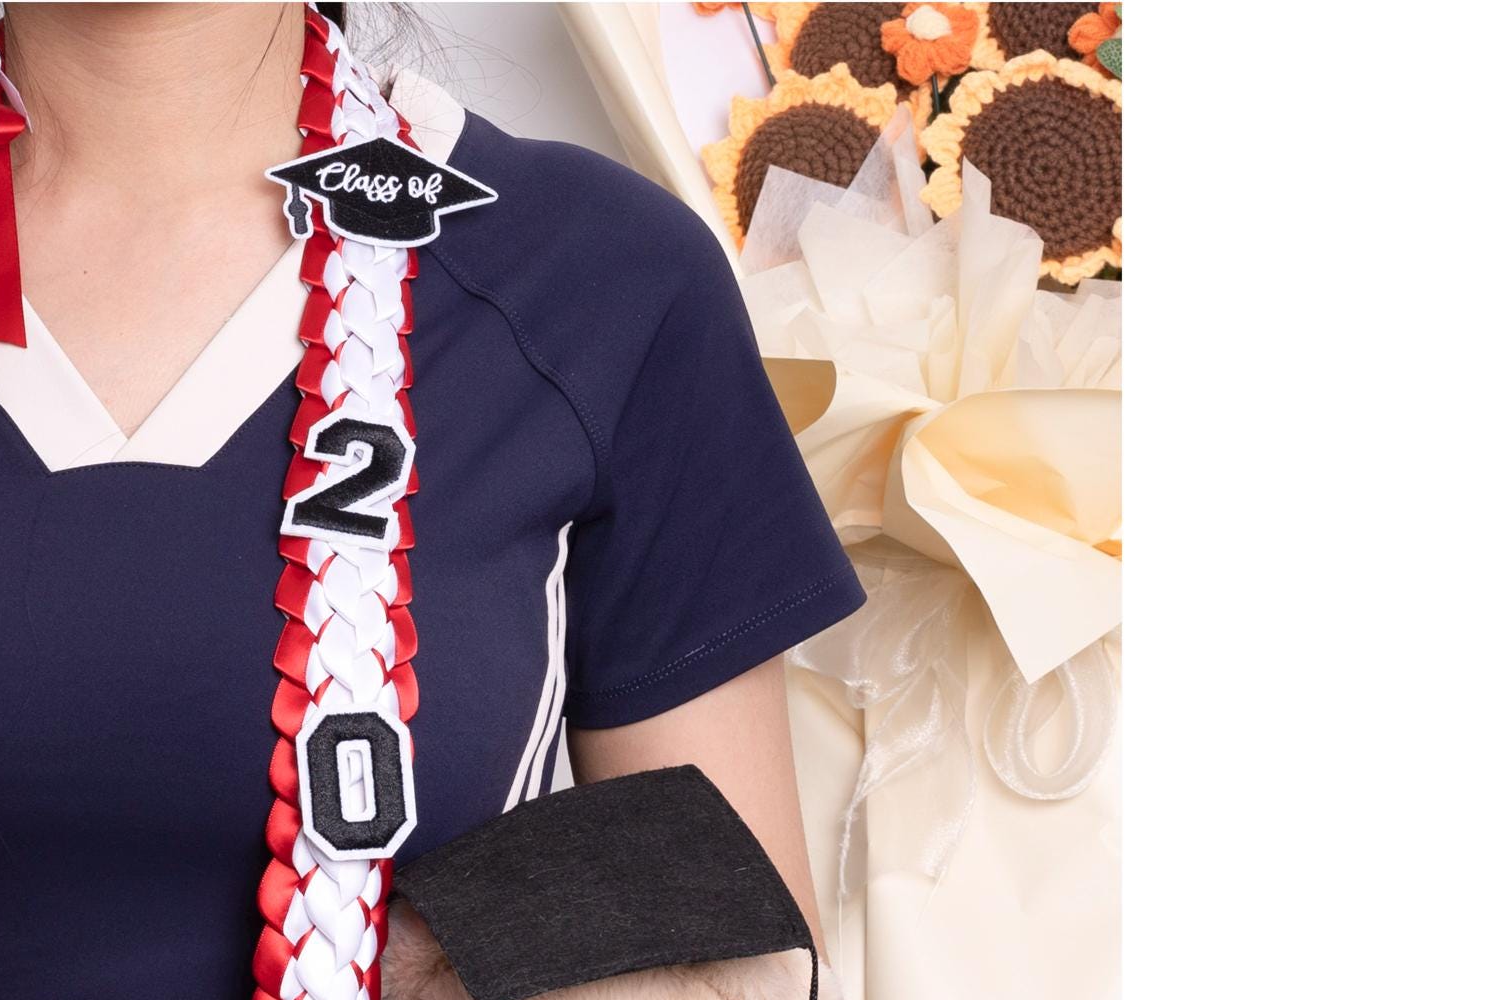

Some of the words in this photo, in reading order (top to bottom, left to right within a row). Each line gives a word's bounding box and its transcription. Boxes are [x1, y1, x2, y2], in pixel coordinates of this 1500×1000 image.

[315, 161, 403, 203] Class
[408, 173, 443, 204] of
[288, 416, 411, 545] 2
[302, 714, 411, 855] 0
